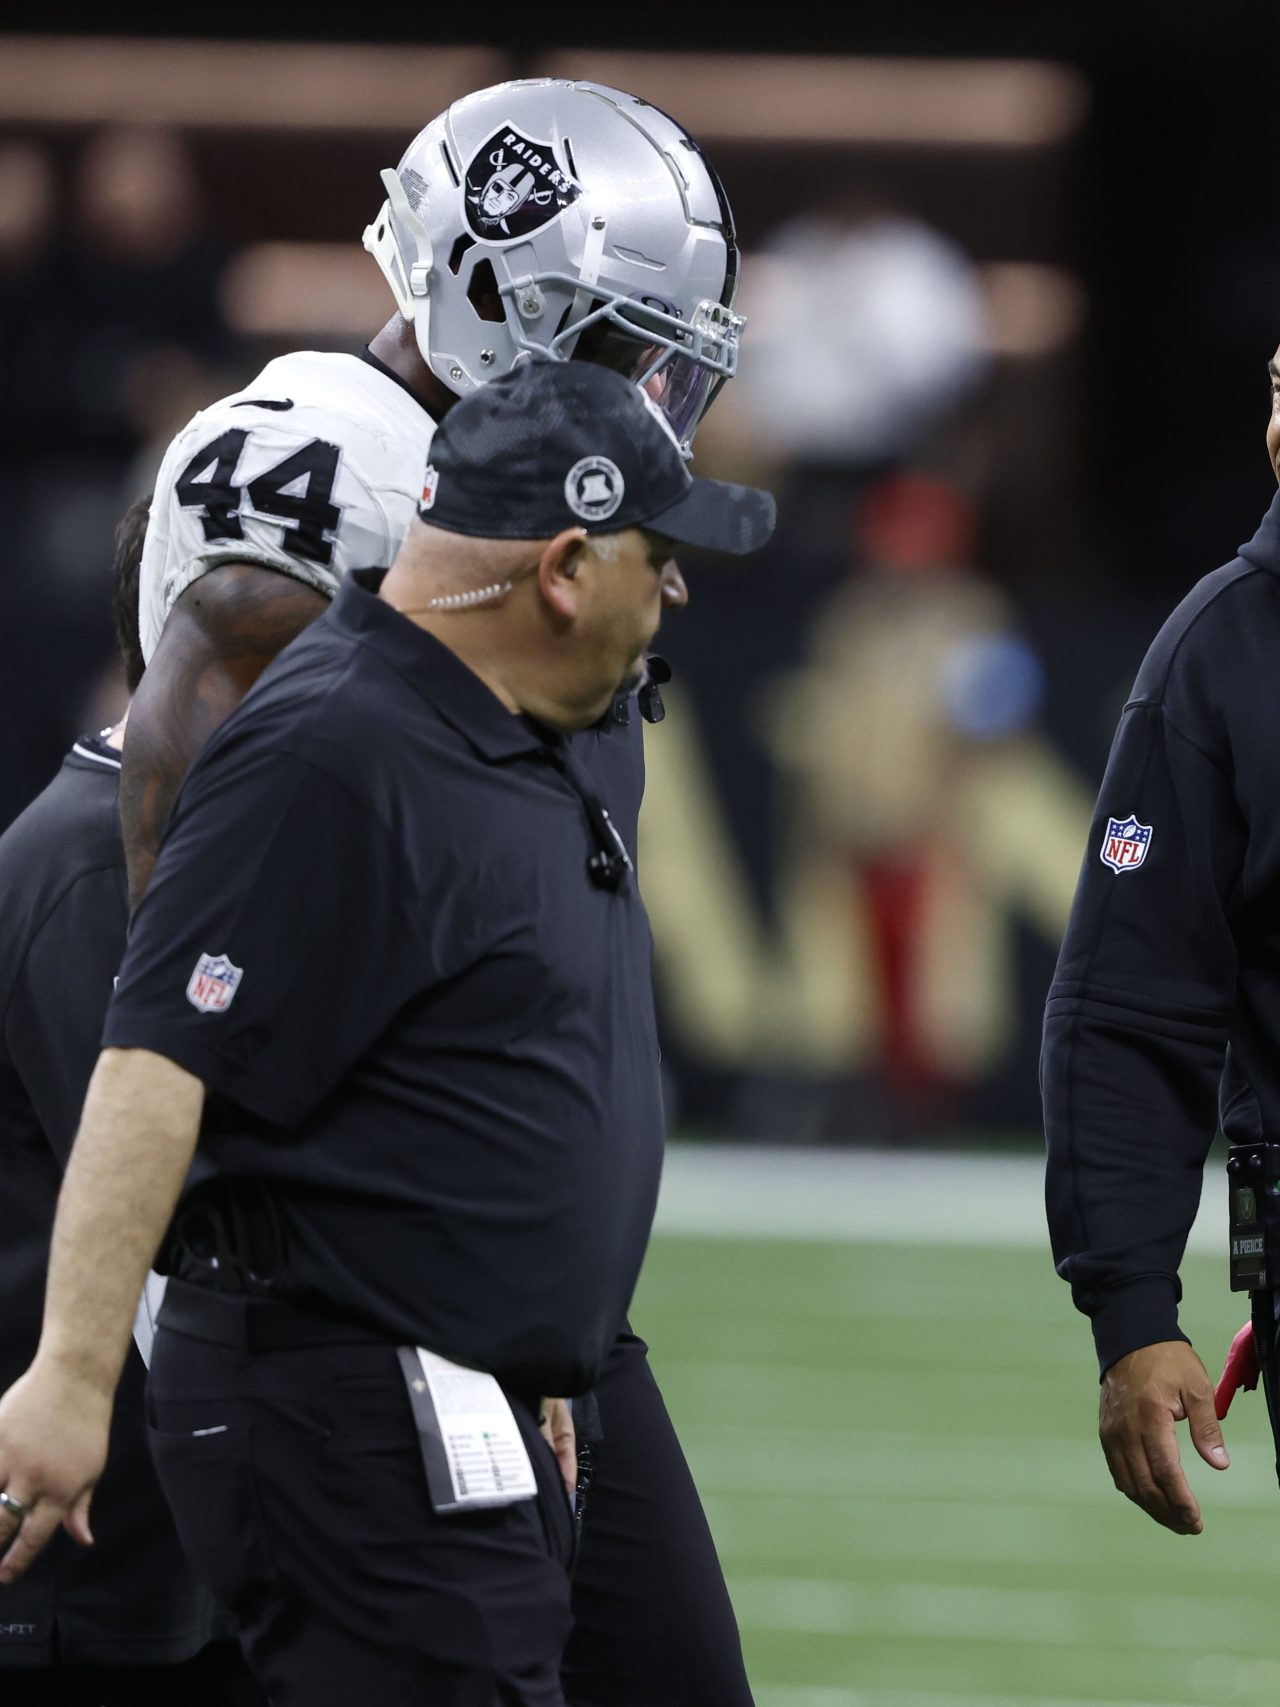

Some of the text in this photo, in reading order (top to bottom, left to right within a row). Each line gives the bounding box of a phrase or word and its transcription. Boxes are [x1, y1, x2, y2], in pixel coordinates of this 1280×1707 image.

[502, 133, 572, 193] RAIDERS
[175, 427, 342, 566] 44
[1106, 838, 1140, 865] NFL
[193, 975, 227, 1008] NFL
[1239, 1238, 1265, 1255] PIERCE
